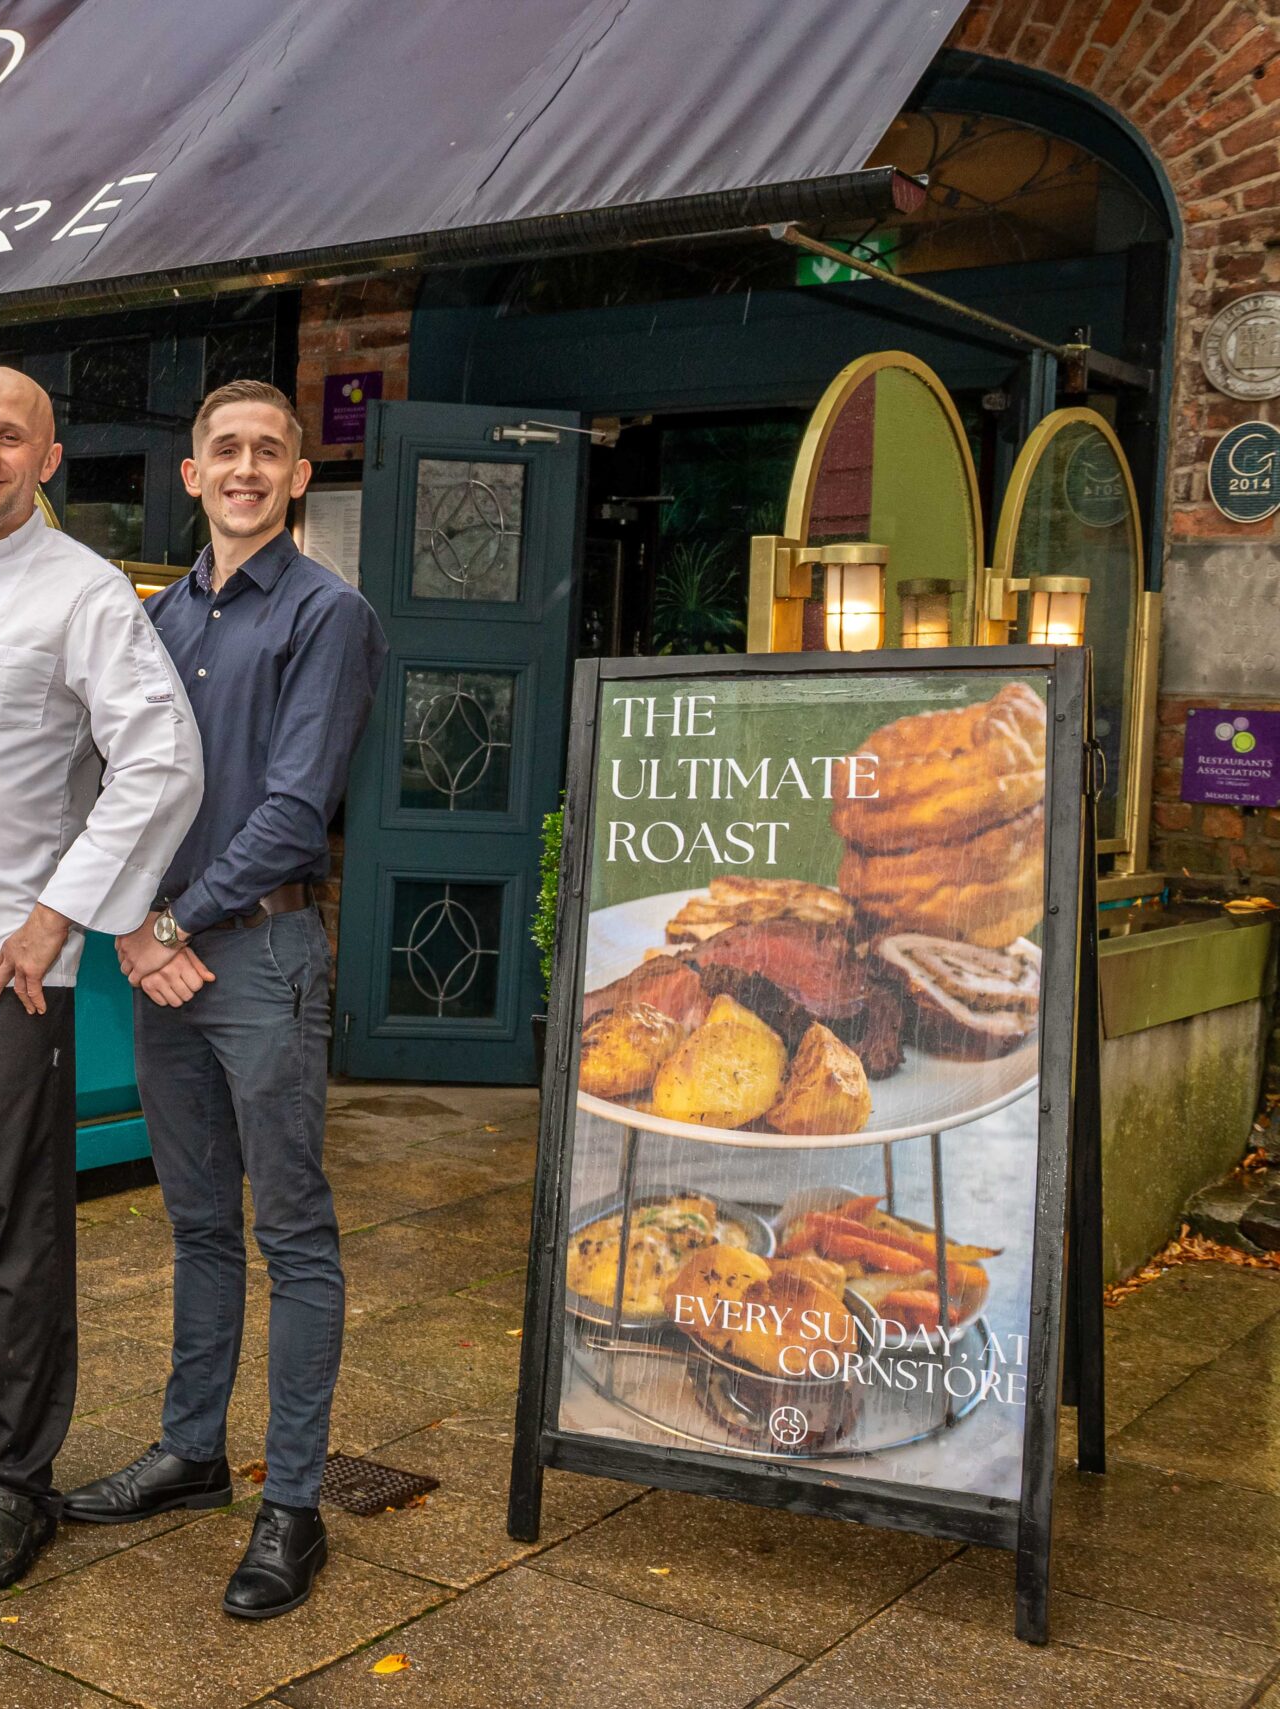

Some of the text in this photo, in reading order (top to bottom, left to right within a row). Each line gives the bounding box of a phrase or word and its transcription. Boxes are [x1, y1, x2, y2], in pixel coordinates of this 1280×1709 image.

[1229, 478, 1271, 490] 2014
[613, 695, 716, 738] THE
[611, 755, 879, 800] ULTIMATE
[1196, 766, 1271, 778] ASSOCIATION
[1198, 756, 1273, 768] RESTAURANTS
[606, 821, 790, 865] ROAST
[673, 1294, 1030, 1366] EVERY SUNDAY, AT
[778, 1345, 1027, 1406] CORNSTORE
